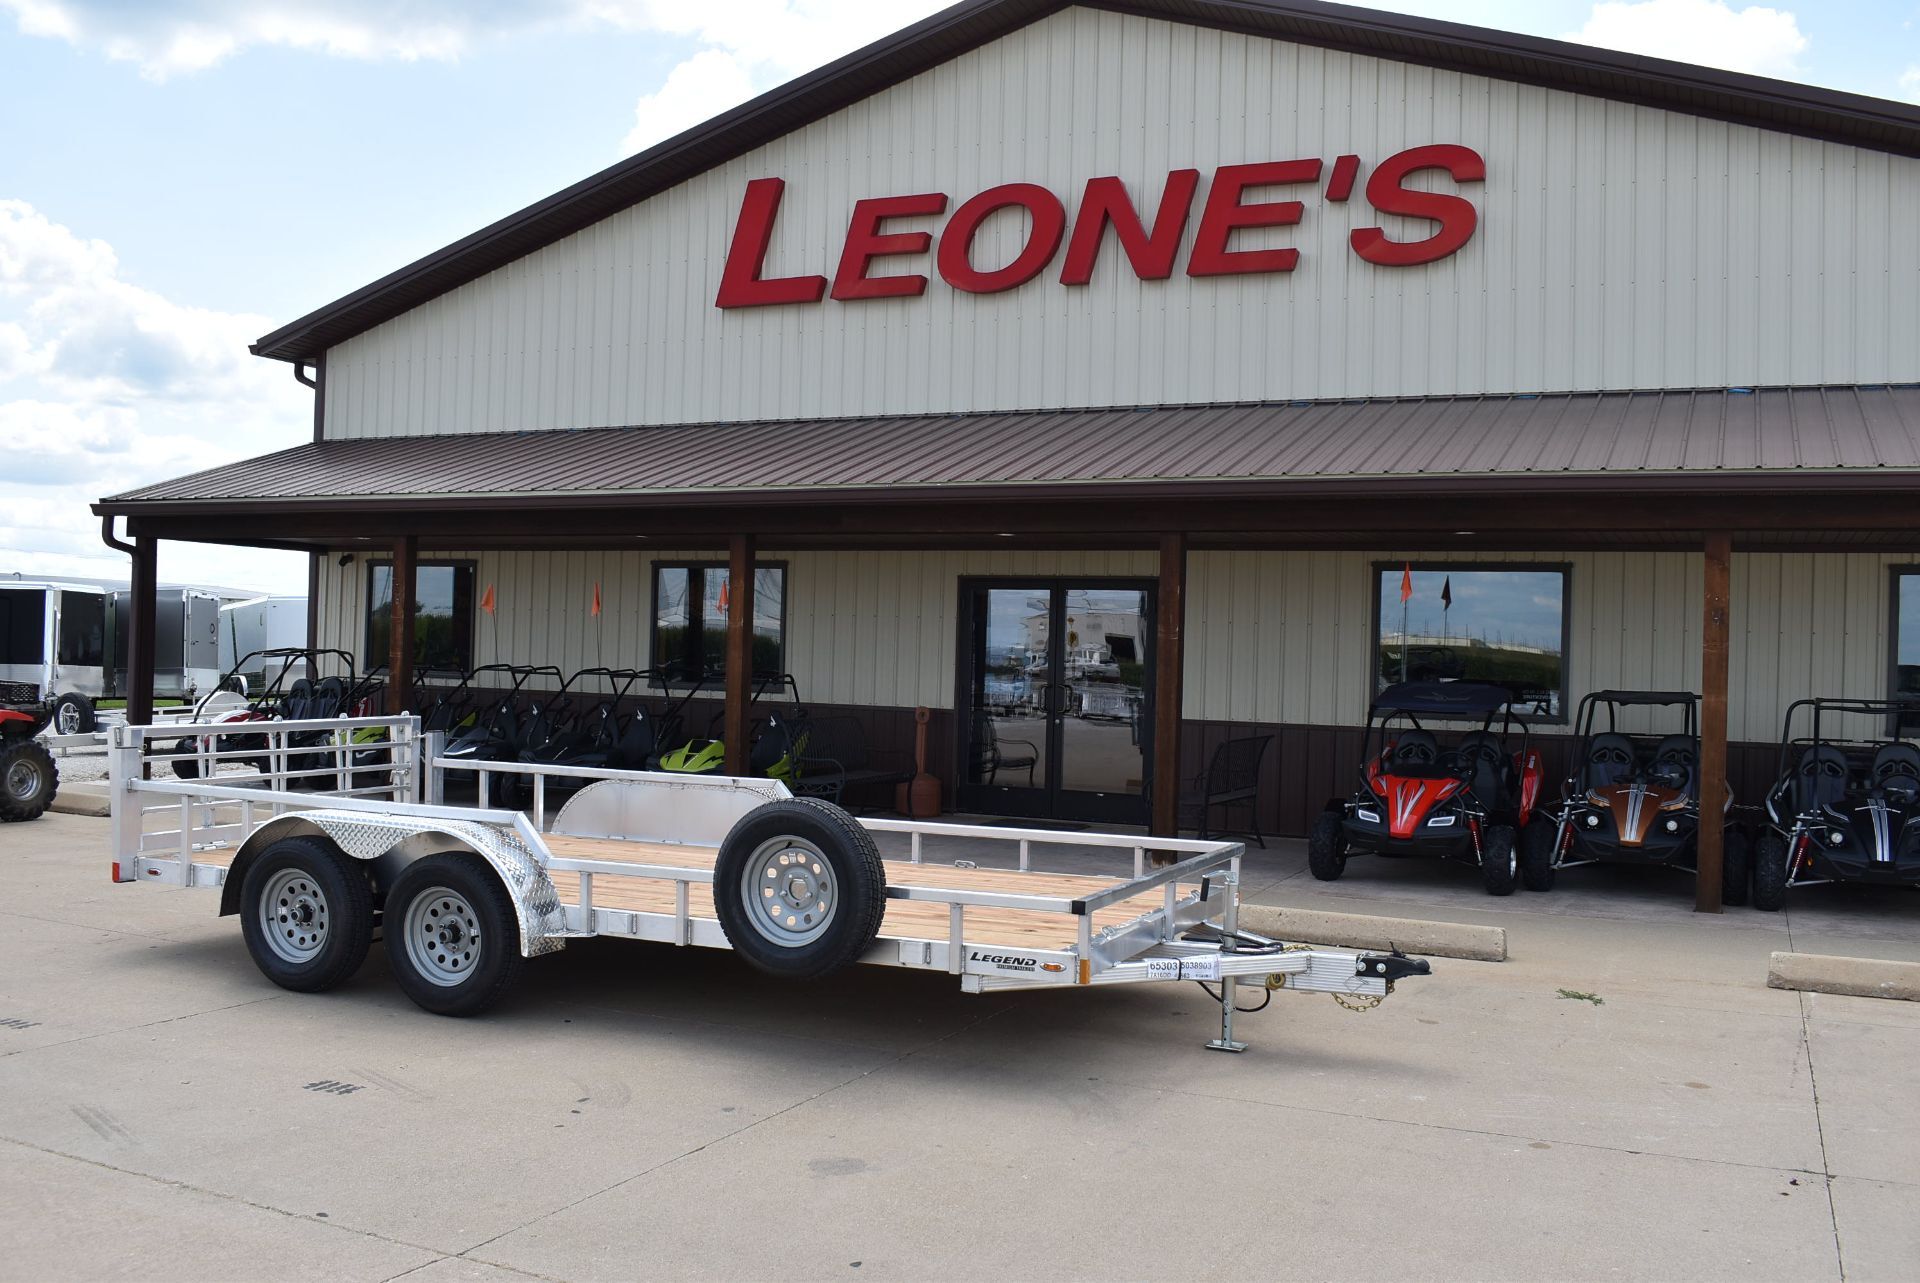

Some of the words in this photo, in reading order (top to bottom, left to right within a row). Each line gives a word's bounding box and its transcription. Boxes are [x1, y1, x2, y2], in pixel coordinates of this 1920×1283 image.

[715, 144, 1486, 309] LEONE'S
[970, 951, 1037, 966] LEGEND
[1150, 961, 1177, 971] 65303
